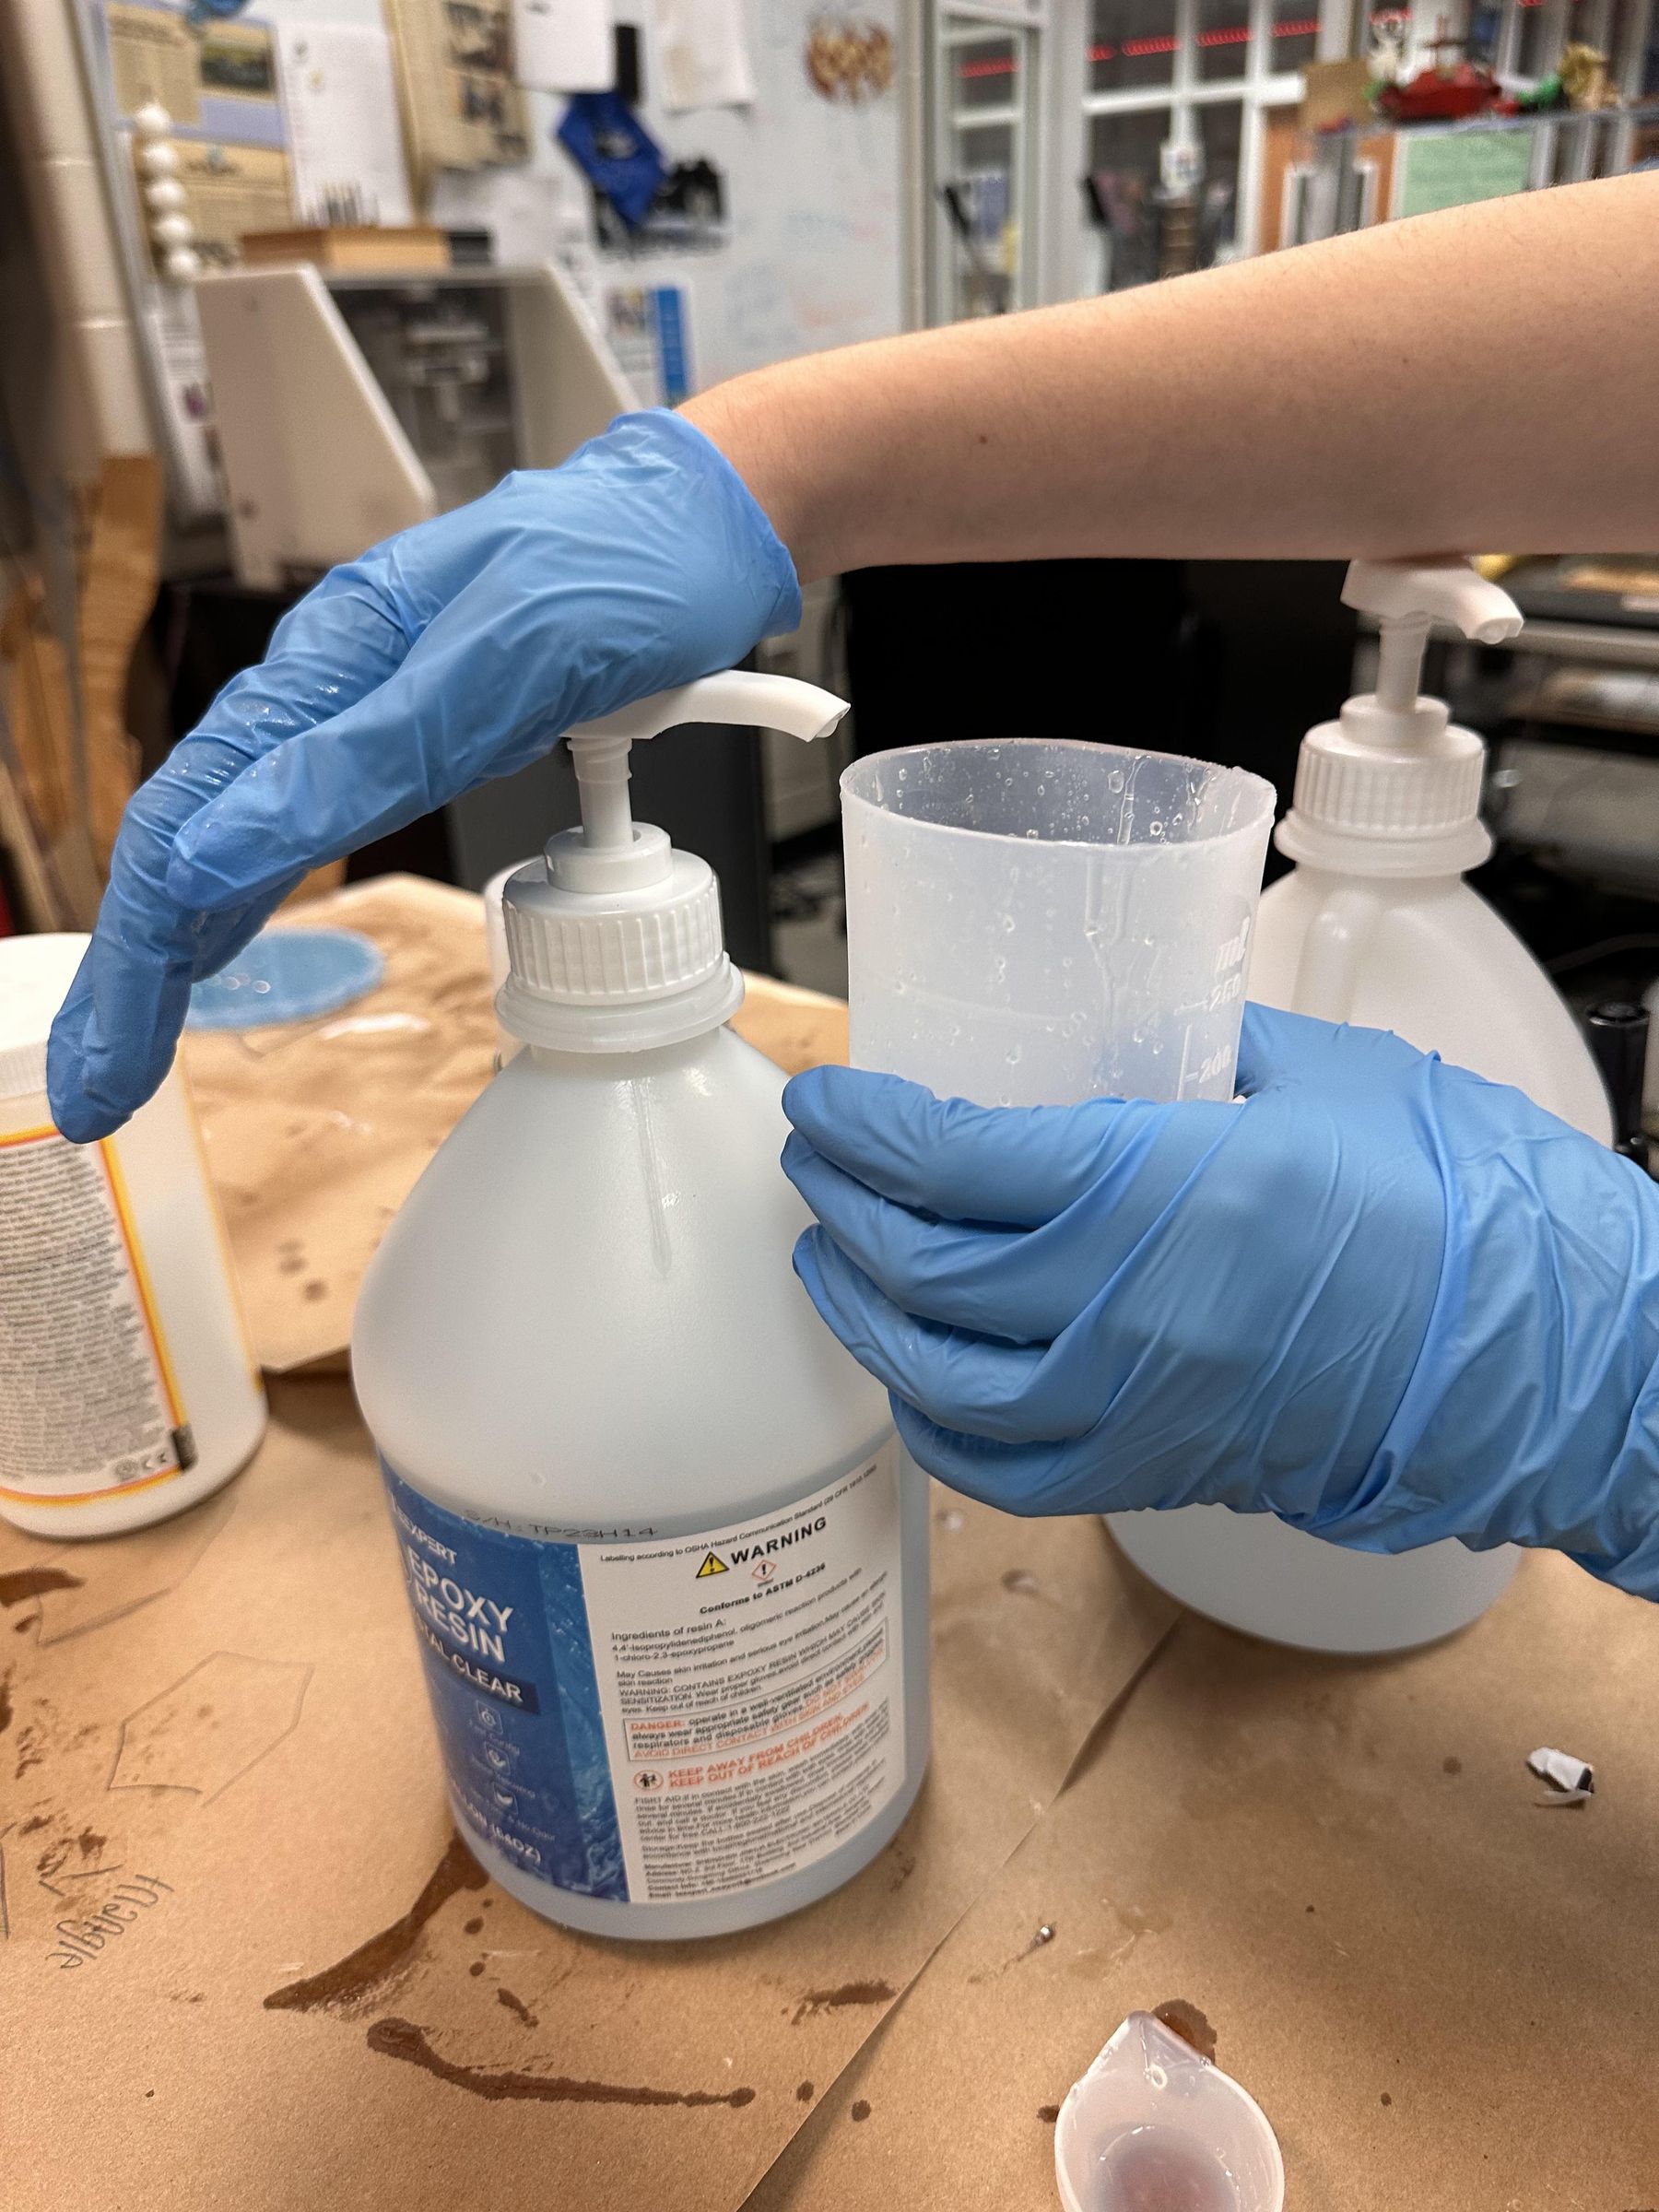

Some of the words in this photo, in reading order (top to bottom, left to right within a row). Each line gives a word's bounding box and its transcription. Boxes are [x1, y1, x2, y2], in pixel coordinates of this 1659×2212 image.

[636, 1549, 674, 1560] according
[685, 1543, 710, 1553] OSHA
[711, 1534, 738, 1548] Hazard
[739, 1514, 794, 1540] Communication
[731, 1516, 827, 1565] WARNING
[407, 1545, 514, 1633] EPOXY
[700, 1595, 750, 1614] Conforms
[752, 1591, 763, 1600] to
[765, 1578, 794, 1595] ASTM
[739, 1613, 783, 1633] oligomeric
[784, 1597, 817, 1617] reaction
[817, 1578, 848, 1603] products
[414, 1579, 506, 1663] RESIN
[611, 1630, 671, 1641] Ingredients
[674, 1626, 685, 1636] of
[687, 1621, 712, 1633] resin
[715, 1618, 727, 1628] A:
[451, 1653, 524, 1703] CLEAR
[617, 1670, 635, 1679] May
[638, 1668, 672, 1677] Causes
[674, 1665, 692, 1676] skin
[693, 1657, 728, 1672] irritation
[729, 1652, 746, 1664] and
[747, 1643, 777, 1658] serious
[673, 1678, 725, 1692] CONTAINS
[768, 1653, 797, 1670] RESIN
[618, 1678, 636, 1687] skin
[638, 1677, 673, 1686] reaction
[696, 1687, 719, 1698] Wear
[721, 1681, 747, 1696] proper
[630, 1720, 686, 1731] DANGER:
[688, 1712, 727, 1725] operate
[729, 1709, 738, 1717] in
[632, 1732, 666, 1741] always
[668, 1728, 693, 1738] wear
[695, 1714, 749, 1735] appropriate
[751, 1706, 780, 1721] safety
[781, 1695, 801, 1712] gear
[803, 1683, 823, 1700] such
[645, 1703, 669, 1712] Keep
[720, 1693, 729, 1701] of
[633, 1736, 690, 1749] respirators
[692, 1735, 712, 1745] and
[714, 1718, 770, 1741] disposable
[633, 1748, 669, 1758] AVOID
[673, 1742, 713, 1755] DIRECT
[715, 1727, 768, 1749] CONTACT
[668, 1766, 703, 1778] KEEP
[707, 1756, 745, 1773] AWAY
[748, 1743, 784, 1762] FROM
[669, 1776, 704, 1788] KEEP
[707, 1770, 734, 1783] OUT
[737, 1765, 753, 1775] OF
[758, 1747, 801, 1769] REACH
[802, 1736, 818, 1751] OF
